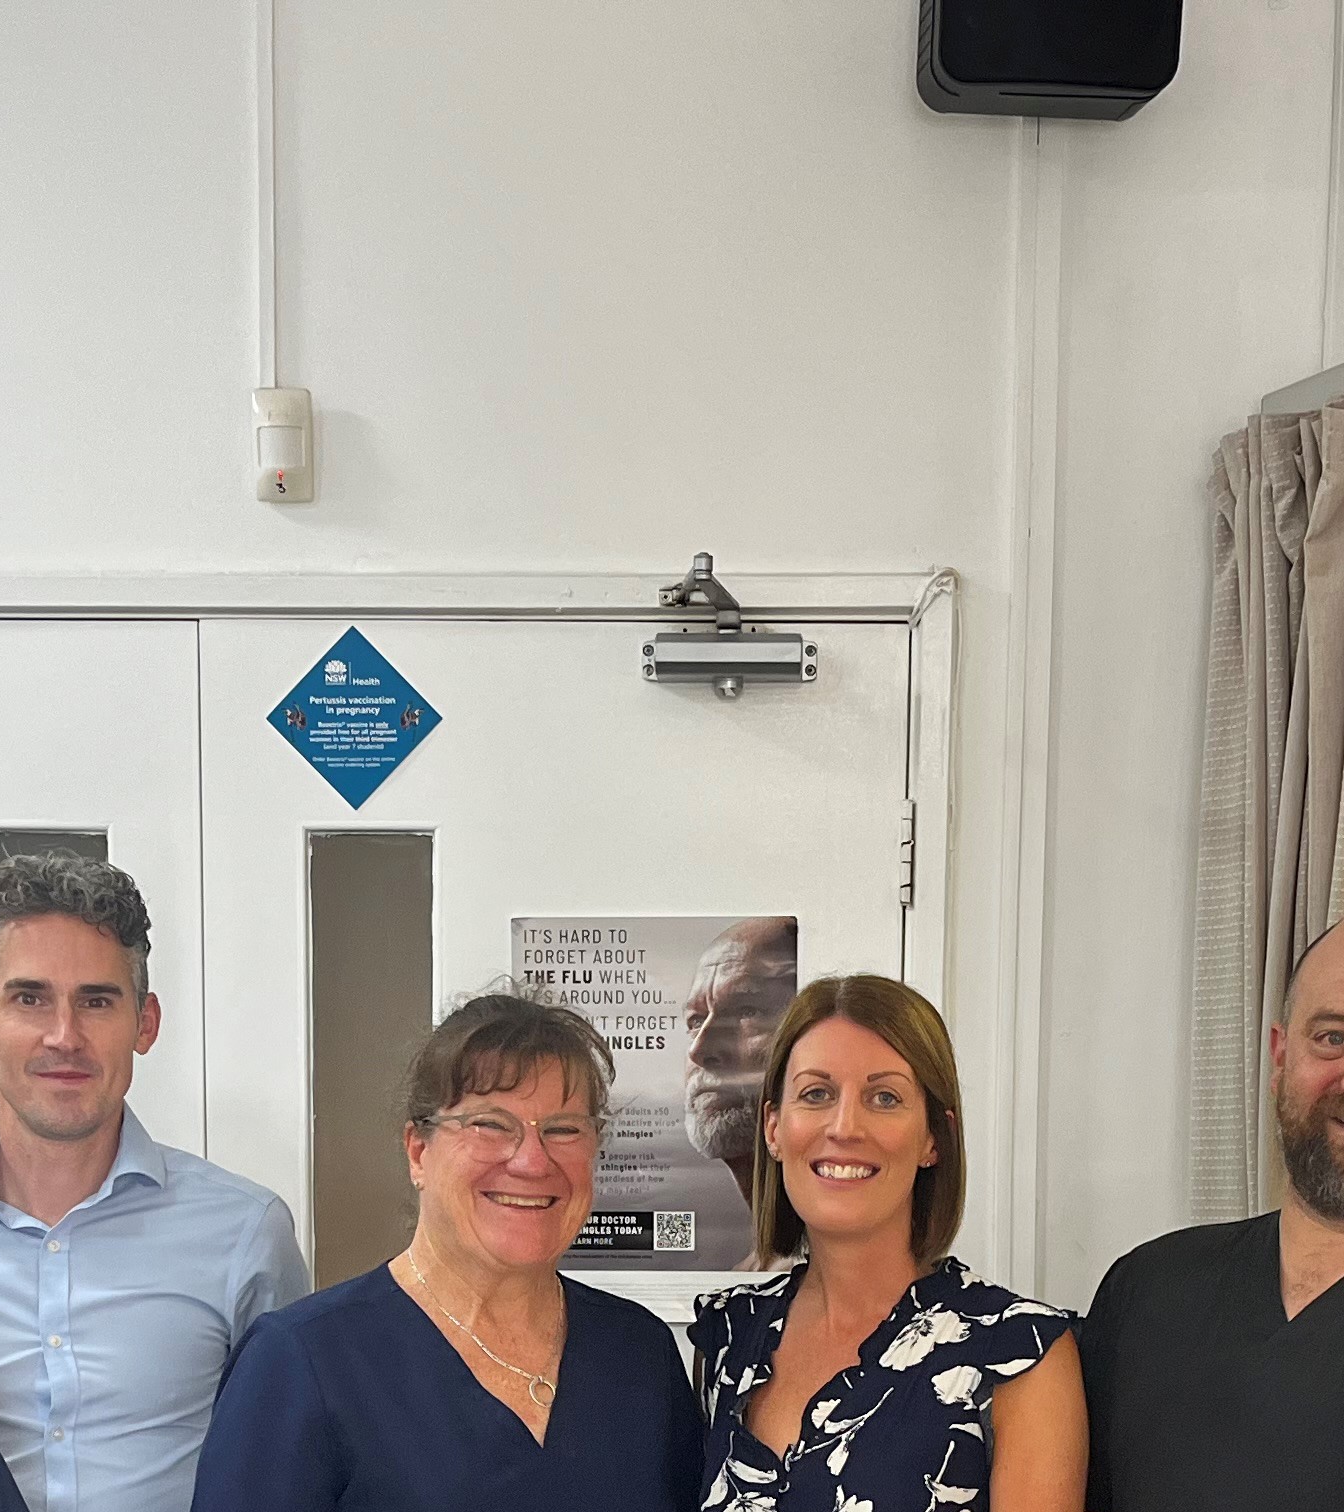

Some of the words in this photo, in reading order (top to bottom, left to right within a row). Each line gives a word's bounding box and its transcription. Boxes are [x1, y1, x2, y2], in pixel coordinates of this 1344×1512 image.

[325, 674, 347, 683] NSW
[352, 678, 381, 686] Health
[309, 696, 347, 704] Pertussis
[348, 696, 396, 704] vaccination
[336, 706, 381, 716] pregnancy
[524, 929, 553, 944] IT'S
[559, 929, 602, 944] HARD
[609, 929, 628, 944] TO
[524, 950, 587, 964] FORGET
[593, 950, 646, 964] ABOUT
[524, 970, 556, 984] THE
[562, 970, 593, 984] FLU
[599, 970, 646, 984] WHEN
[559, 990, 625, 1005] AROUND
[585, 1015, 609, 1030] N'T
[616, 1015, 678, 1030] FORGET
[607, 1036, 665, 1050] INGLES
[625, 1107, 652, 1115] adults
[608, 1153, 637, 1161] people
[638, 1152, 655, 1160] risk
[600, 1163, 638, 1173] shingles
[601, 1216, 637, 1225] DOCTOR
[580, 1226, 612, 1235] NGLES
[614, 1226, 643, 1235] TODAY
